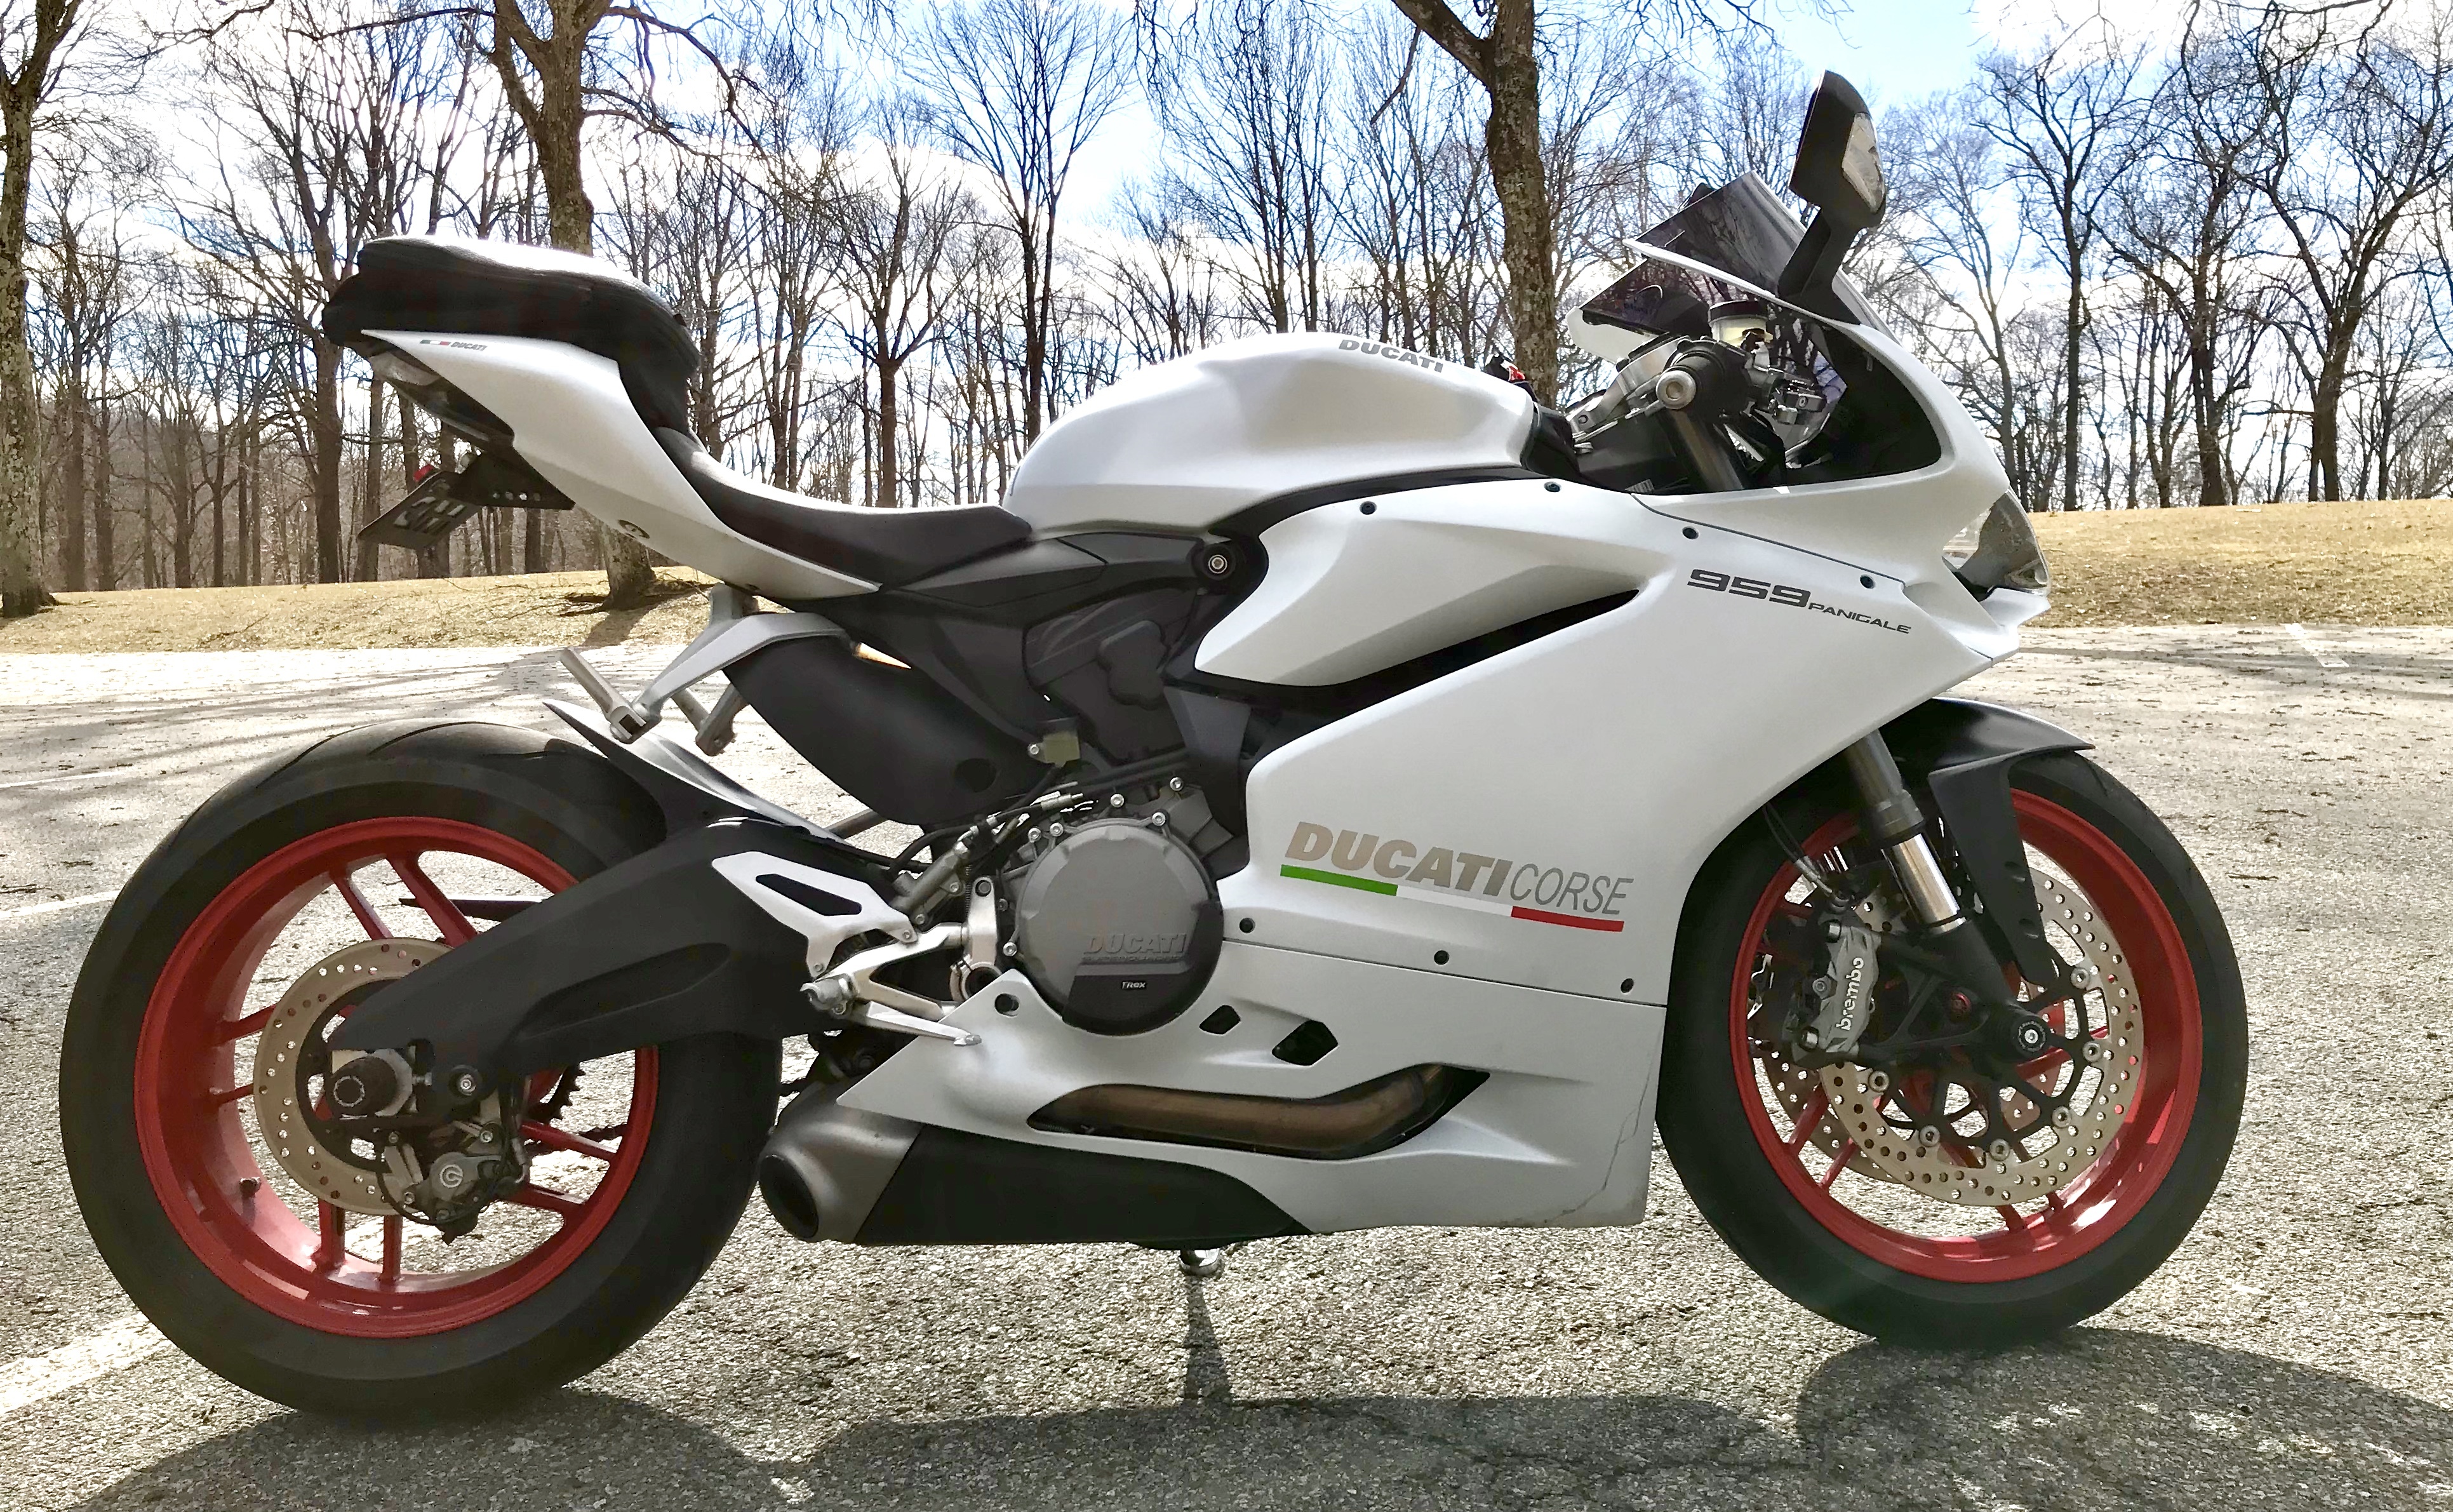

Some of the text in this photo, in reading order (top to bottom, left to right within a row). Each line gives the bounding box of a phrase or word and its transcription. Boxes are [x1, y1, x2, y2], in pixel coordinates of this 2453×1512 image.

[450, 342, 488, 351] DUCATI
[1338, 338, 1444, 373] DUCATI
[1687, 568, 1911, 634] 959 PANIGALE
[1285, 821, 1634, 916] DUCATI CORSE
[1083, 933, 1187, 955] DUCATI
[1835, 956, 1864, 1031] brembo
